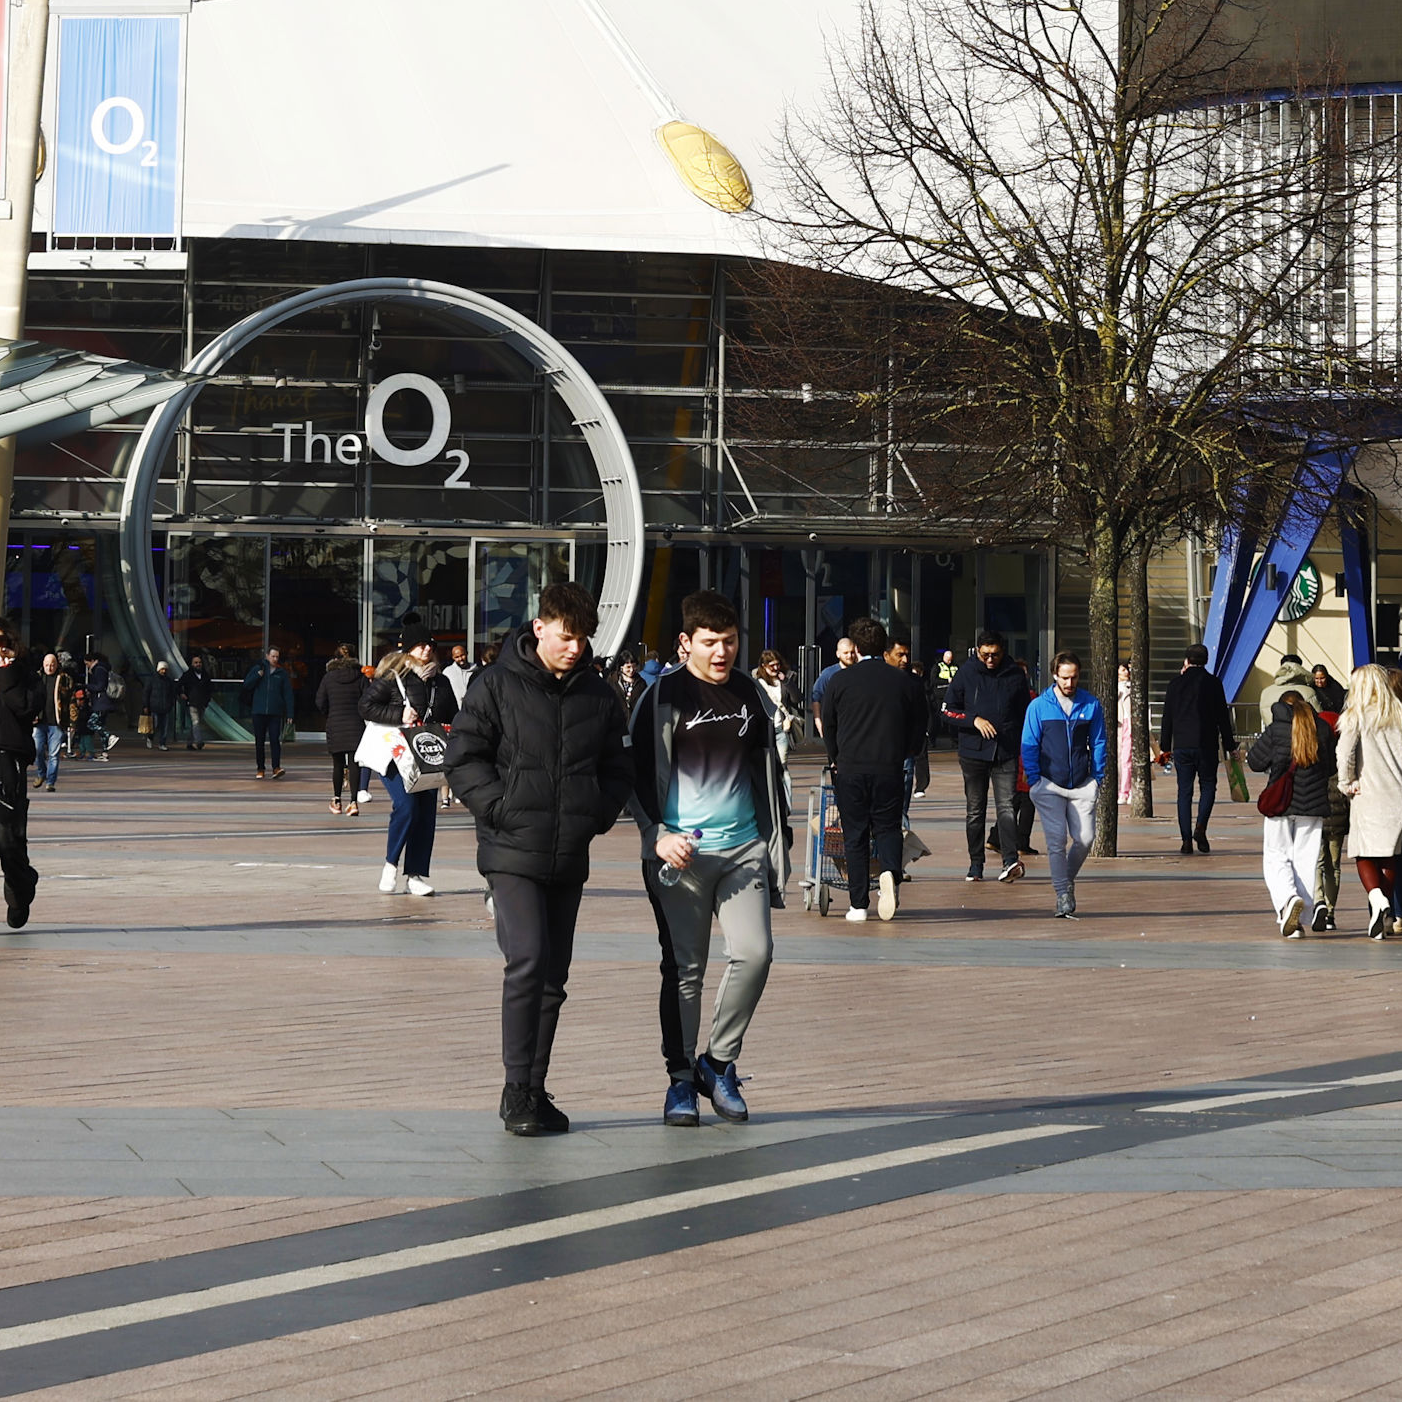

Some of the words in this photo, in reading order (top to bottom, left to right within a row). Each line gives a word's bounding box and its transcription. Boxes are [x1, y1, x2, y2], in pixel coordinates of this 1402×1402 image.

[90, 96, 159, 167] O2
[272, 420, 363, 465] The
[364, 372, 471, 489] O2
